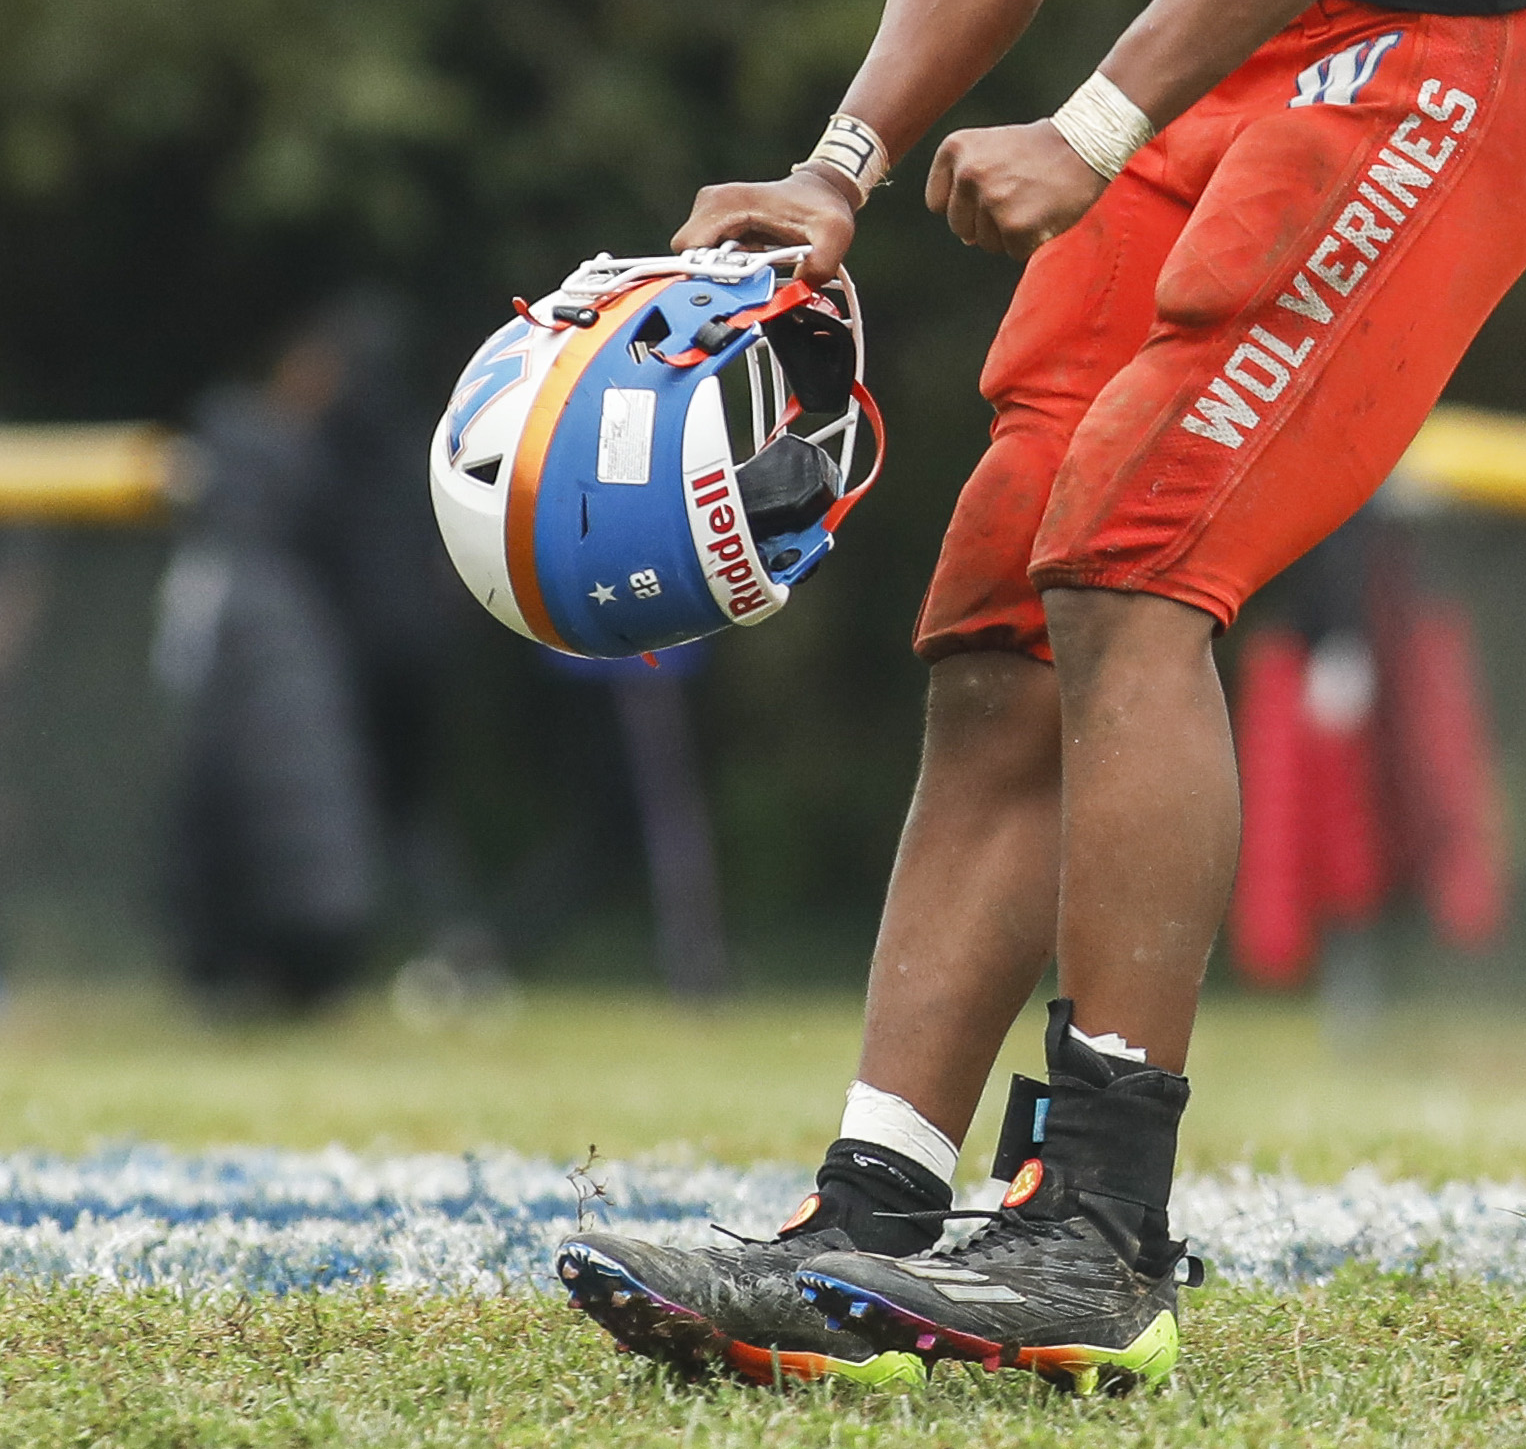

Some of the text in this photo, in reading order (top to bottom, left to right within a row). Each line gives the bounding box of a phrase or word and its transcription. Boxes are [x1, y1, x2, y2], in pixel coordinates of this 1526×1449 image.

[1180, 77, 1478, 450] WOLVERINES
[629, 568, 662, 600] 22
[691, 468, 769, 618] Riddell
